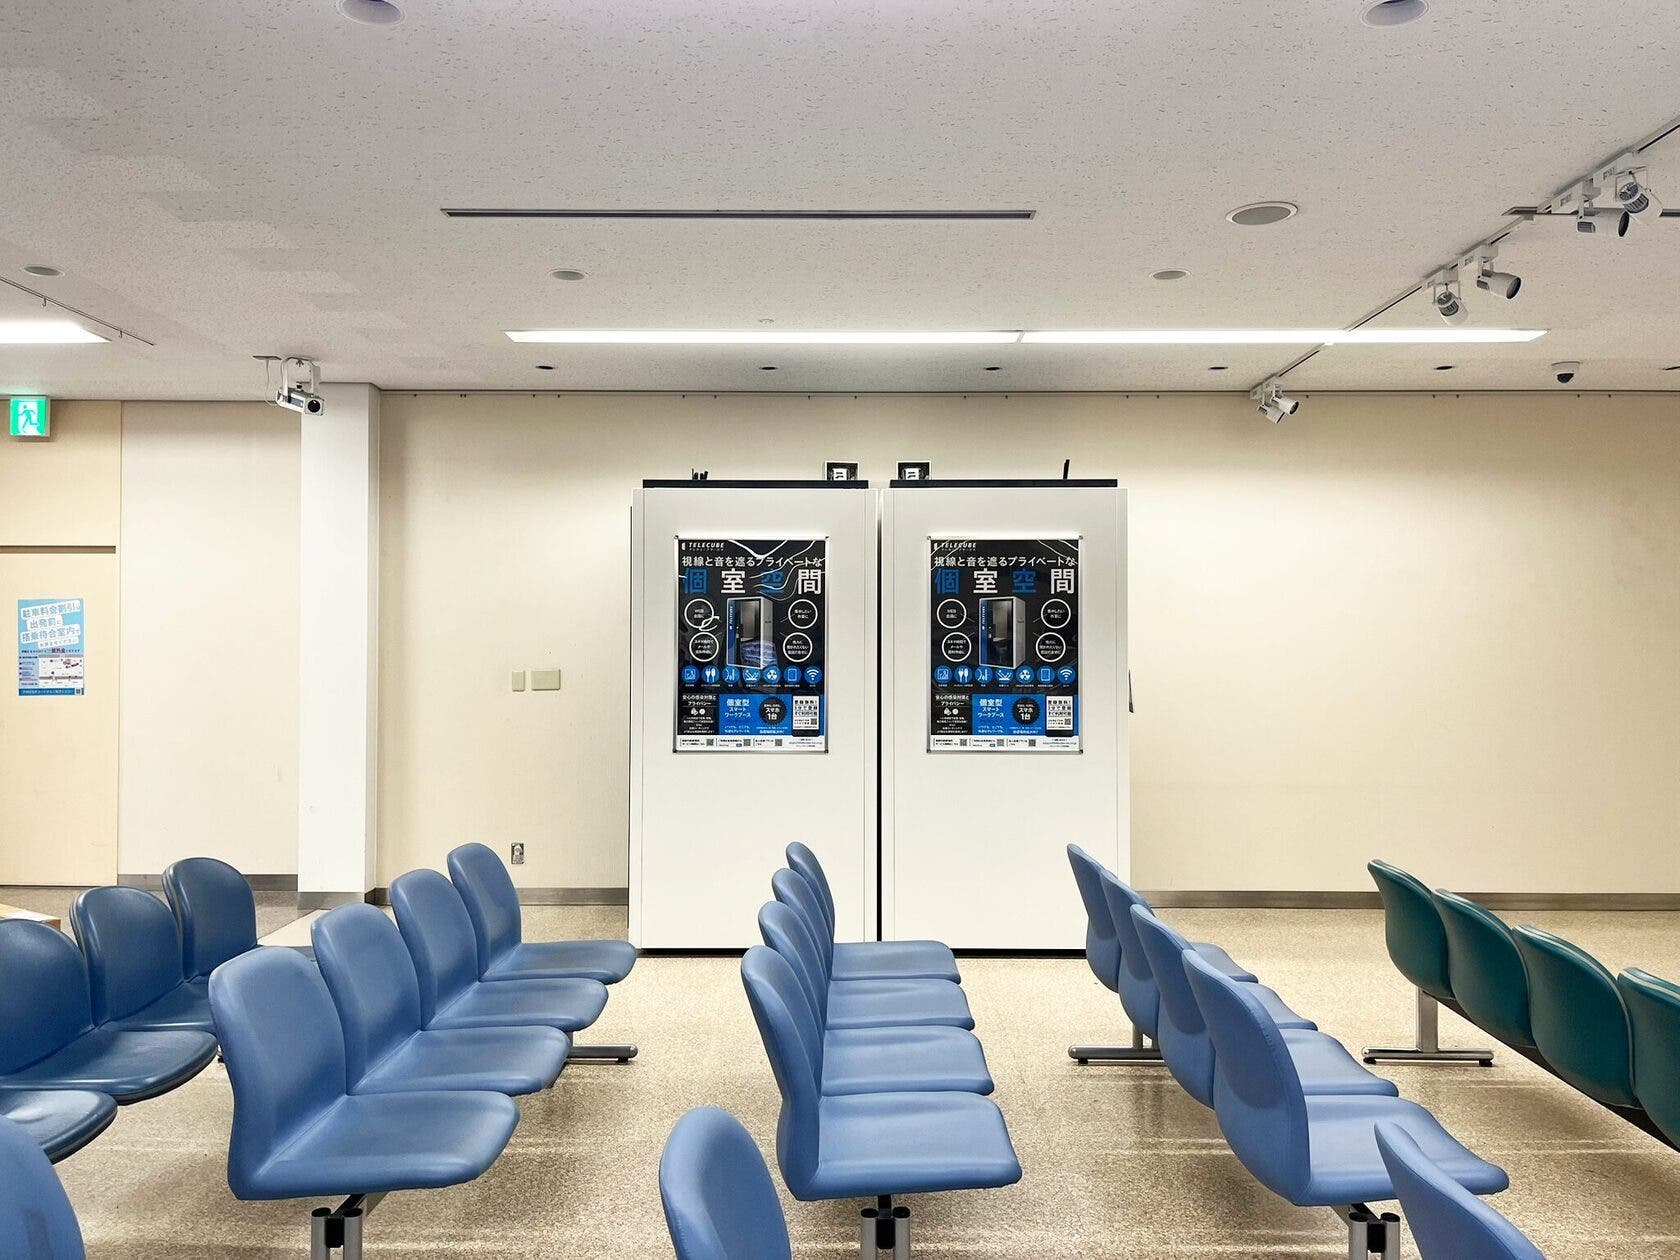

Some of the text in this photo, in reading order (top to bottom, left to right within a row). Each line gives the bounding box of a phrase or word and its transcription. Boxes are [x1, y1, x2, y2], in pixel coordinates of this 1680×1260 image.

[682, 556, 823, 567] 視線と音を遮るプライベートな
[934, 556, 1077, 567] 視線と音を遮るプライベートな
[683, 568, 822, 594] 個室空間
[934, 568, 1075, 594] 個室空間
[726, 698, 750, 707] 個室型
[979, 698, 1003, 707] 個室型
